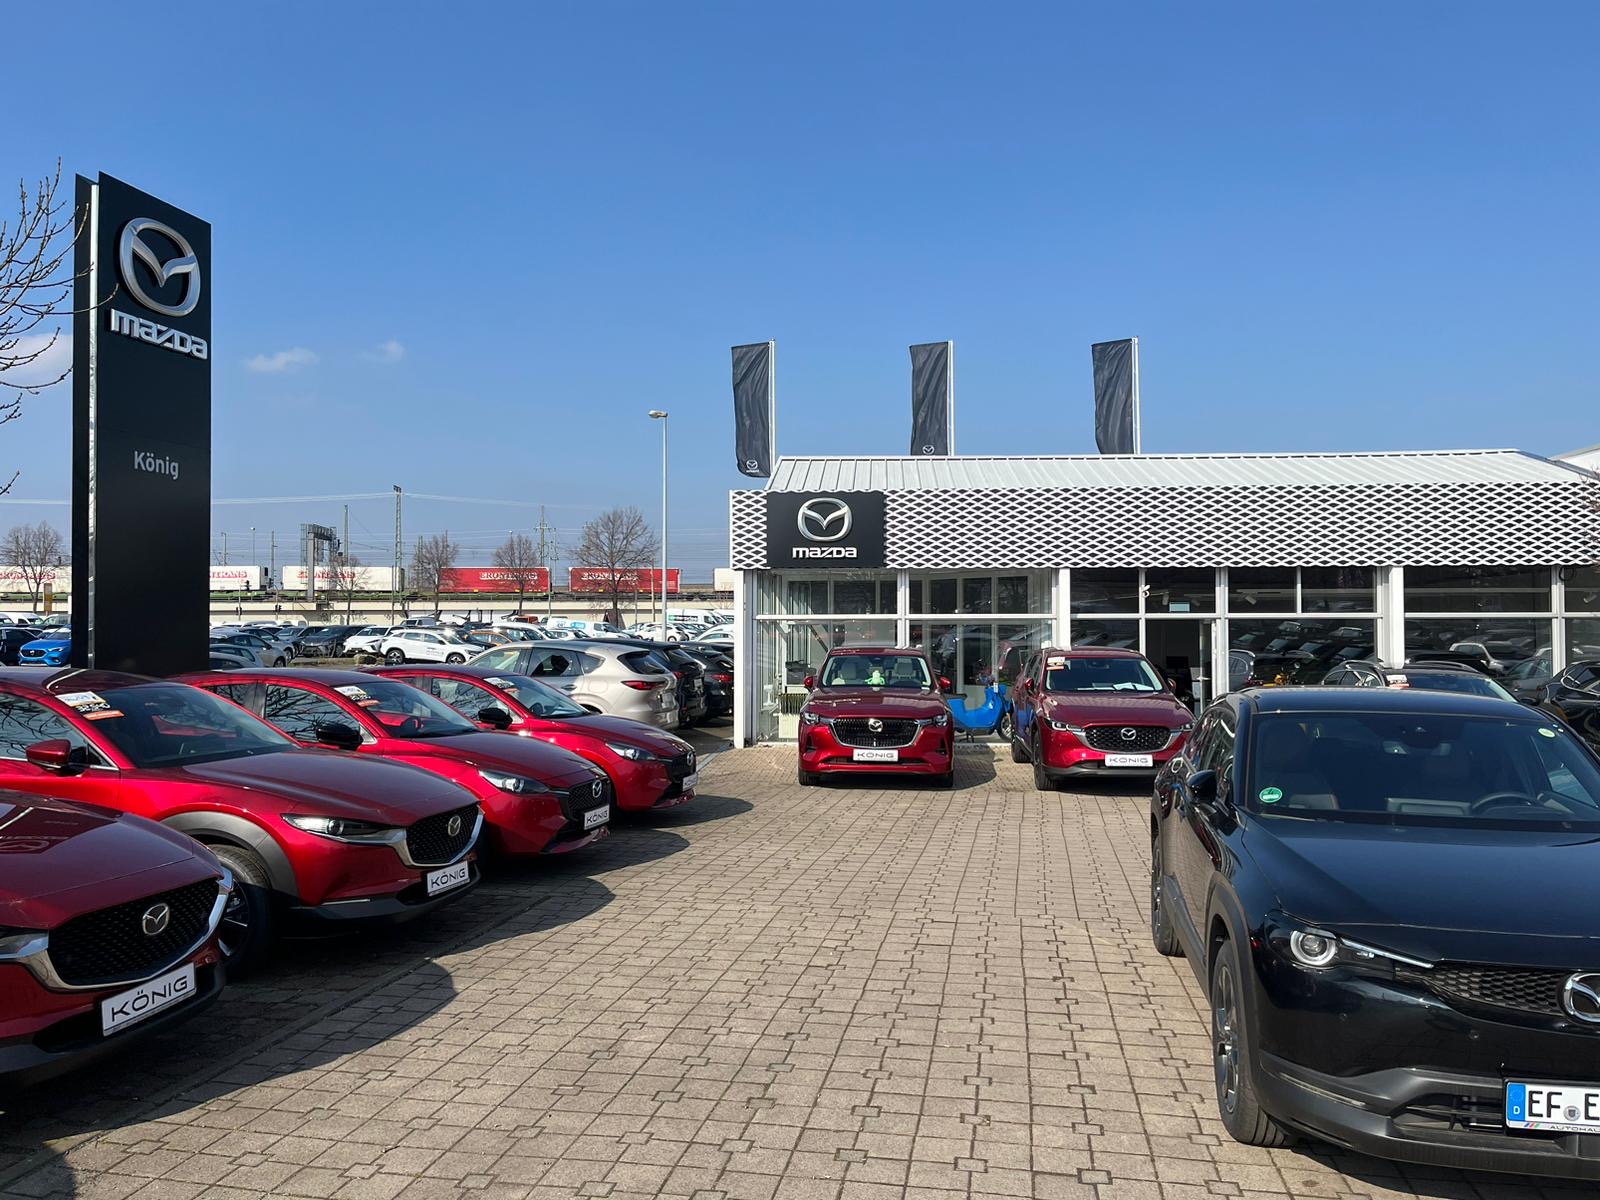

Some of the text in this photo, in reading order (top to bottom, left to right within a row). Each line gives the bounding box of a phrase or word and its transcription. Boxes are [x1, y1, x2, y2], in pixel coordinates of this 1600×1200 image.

[134, 450, 179, 480] König
[431, 868, 466, 888] KÖNIG
[111, 975, 188, 1022] KÖNIG
[1513, 1106, 1521, 1115] D
[1528, 1091, 1563, 1118] EF
